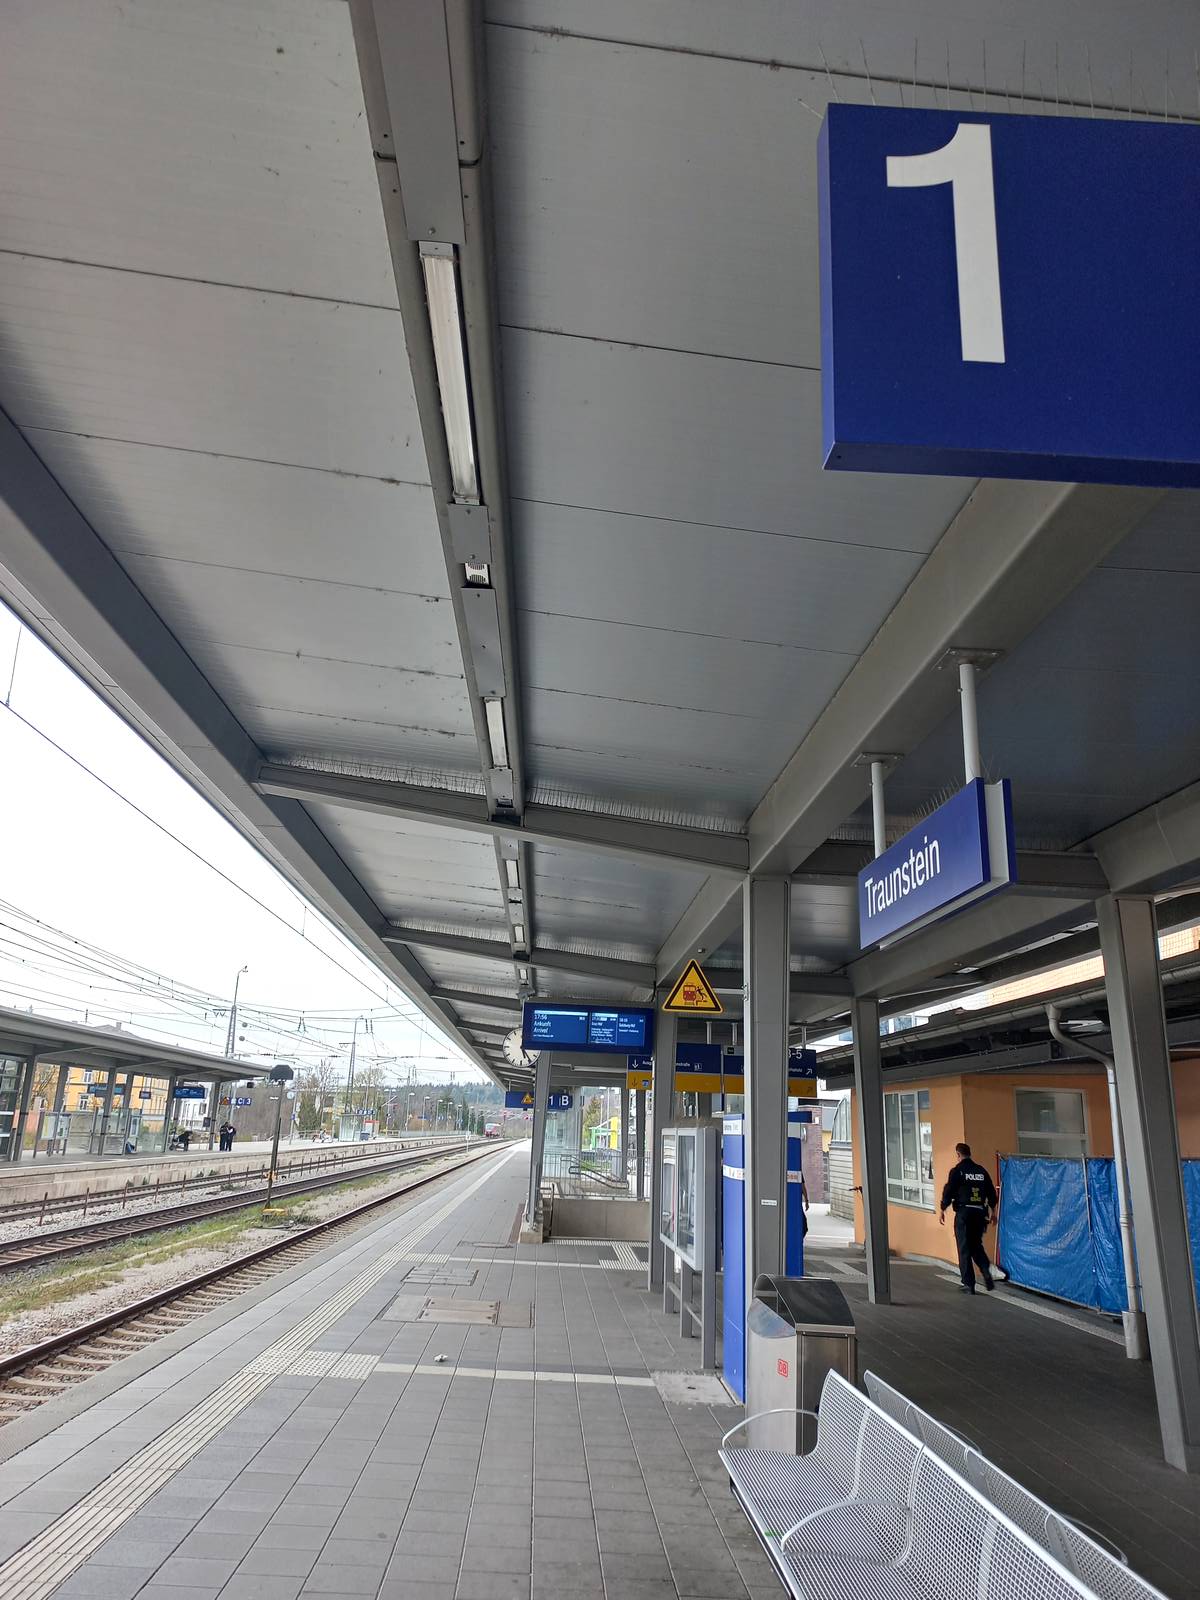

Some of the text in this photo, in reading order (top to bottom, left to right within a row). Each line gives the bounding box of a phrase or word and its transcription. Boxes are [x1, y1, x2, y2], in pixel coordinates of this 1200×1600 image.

[886, 123, 1006, 364] 1
[864, 835, 941, 919] Traunstein
[549, 1095, 569, 1106] 1 B
[965, 1173, 985, 1181] POLIZEI
[778, 1360, 788, 1376] DB
